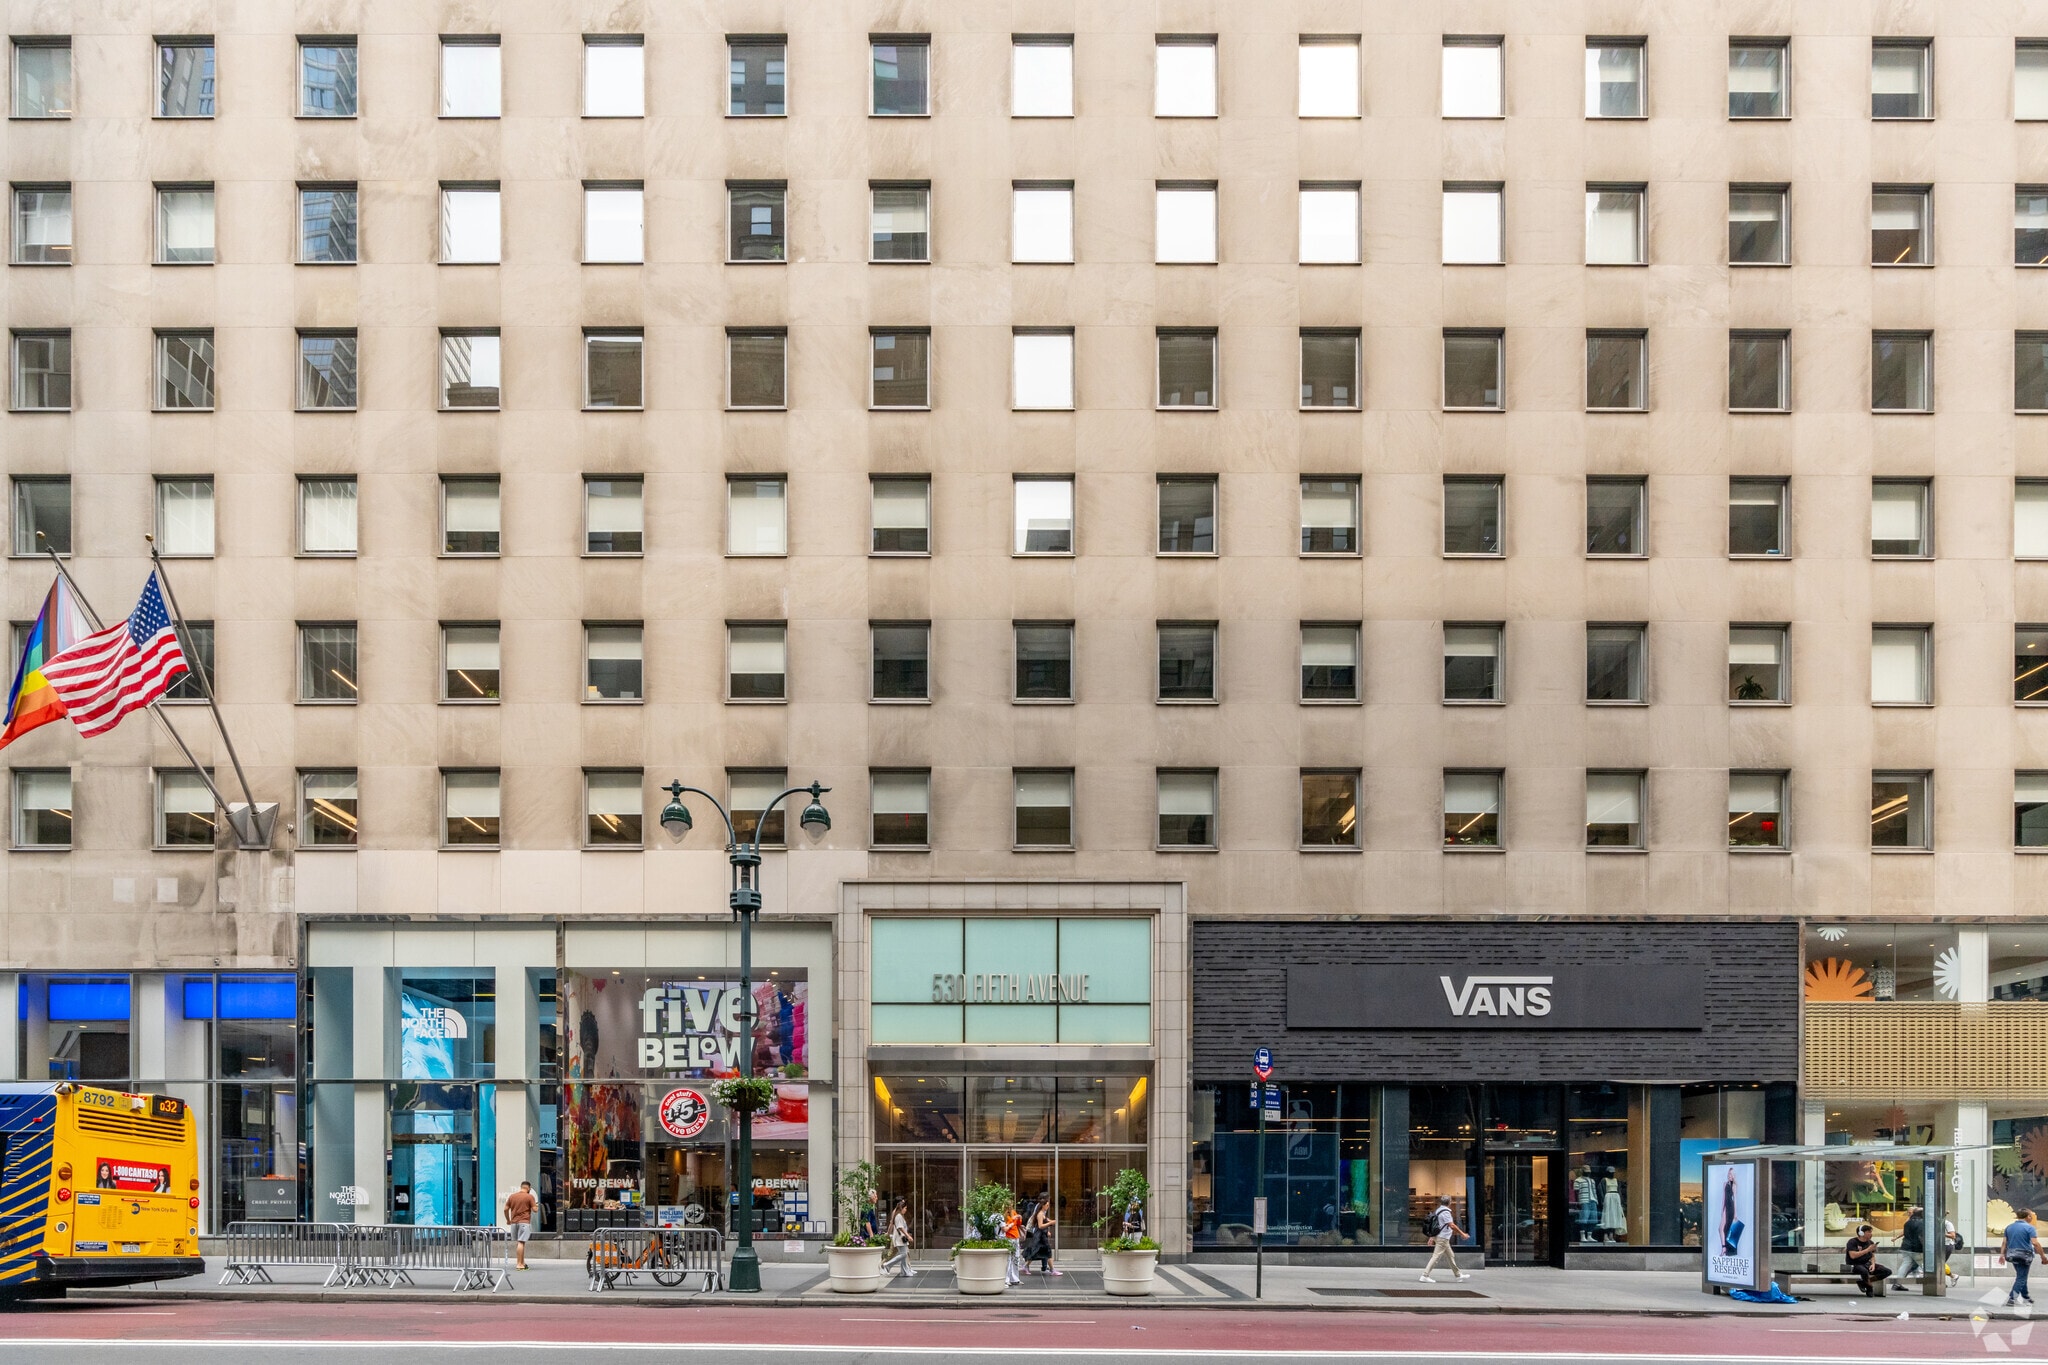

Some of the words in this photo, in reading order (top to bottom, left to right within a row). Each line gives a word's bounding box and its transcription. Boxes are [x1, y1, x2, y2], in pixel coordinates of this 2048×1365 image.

[932, 974, 966, 1001] 530
[974, 974, 1020, 1001] FIFTH
[1026, 974, 1089, 1001] AVENUE
[1440, 976, 1553, 1016] VANS
[421, 1008, 444, 1018] THE
[639, 987, 757, 1032] five
[402, 1018, 444, 1028] NORTH
[414, 1028, 444, 1038] FACE
[638, 1037, 755, 1068] BELOW
[84, 1091, 115, 1108] 8792
[572, 1179, 597, 1188] five
[599, 1179, 633, 1188] BELOW
[766, 1179, 800, 1188] BELOW
[1712, 1256, 1749, 1268] SAPPHIRE
[1714, 1265, 1748, 1276] RESERVE
